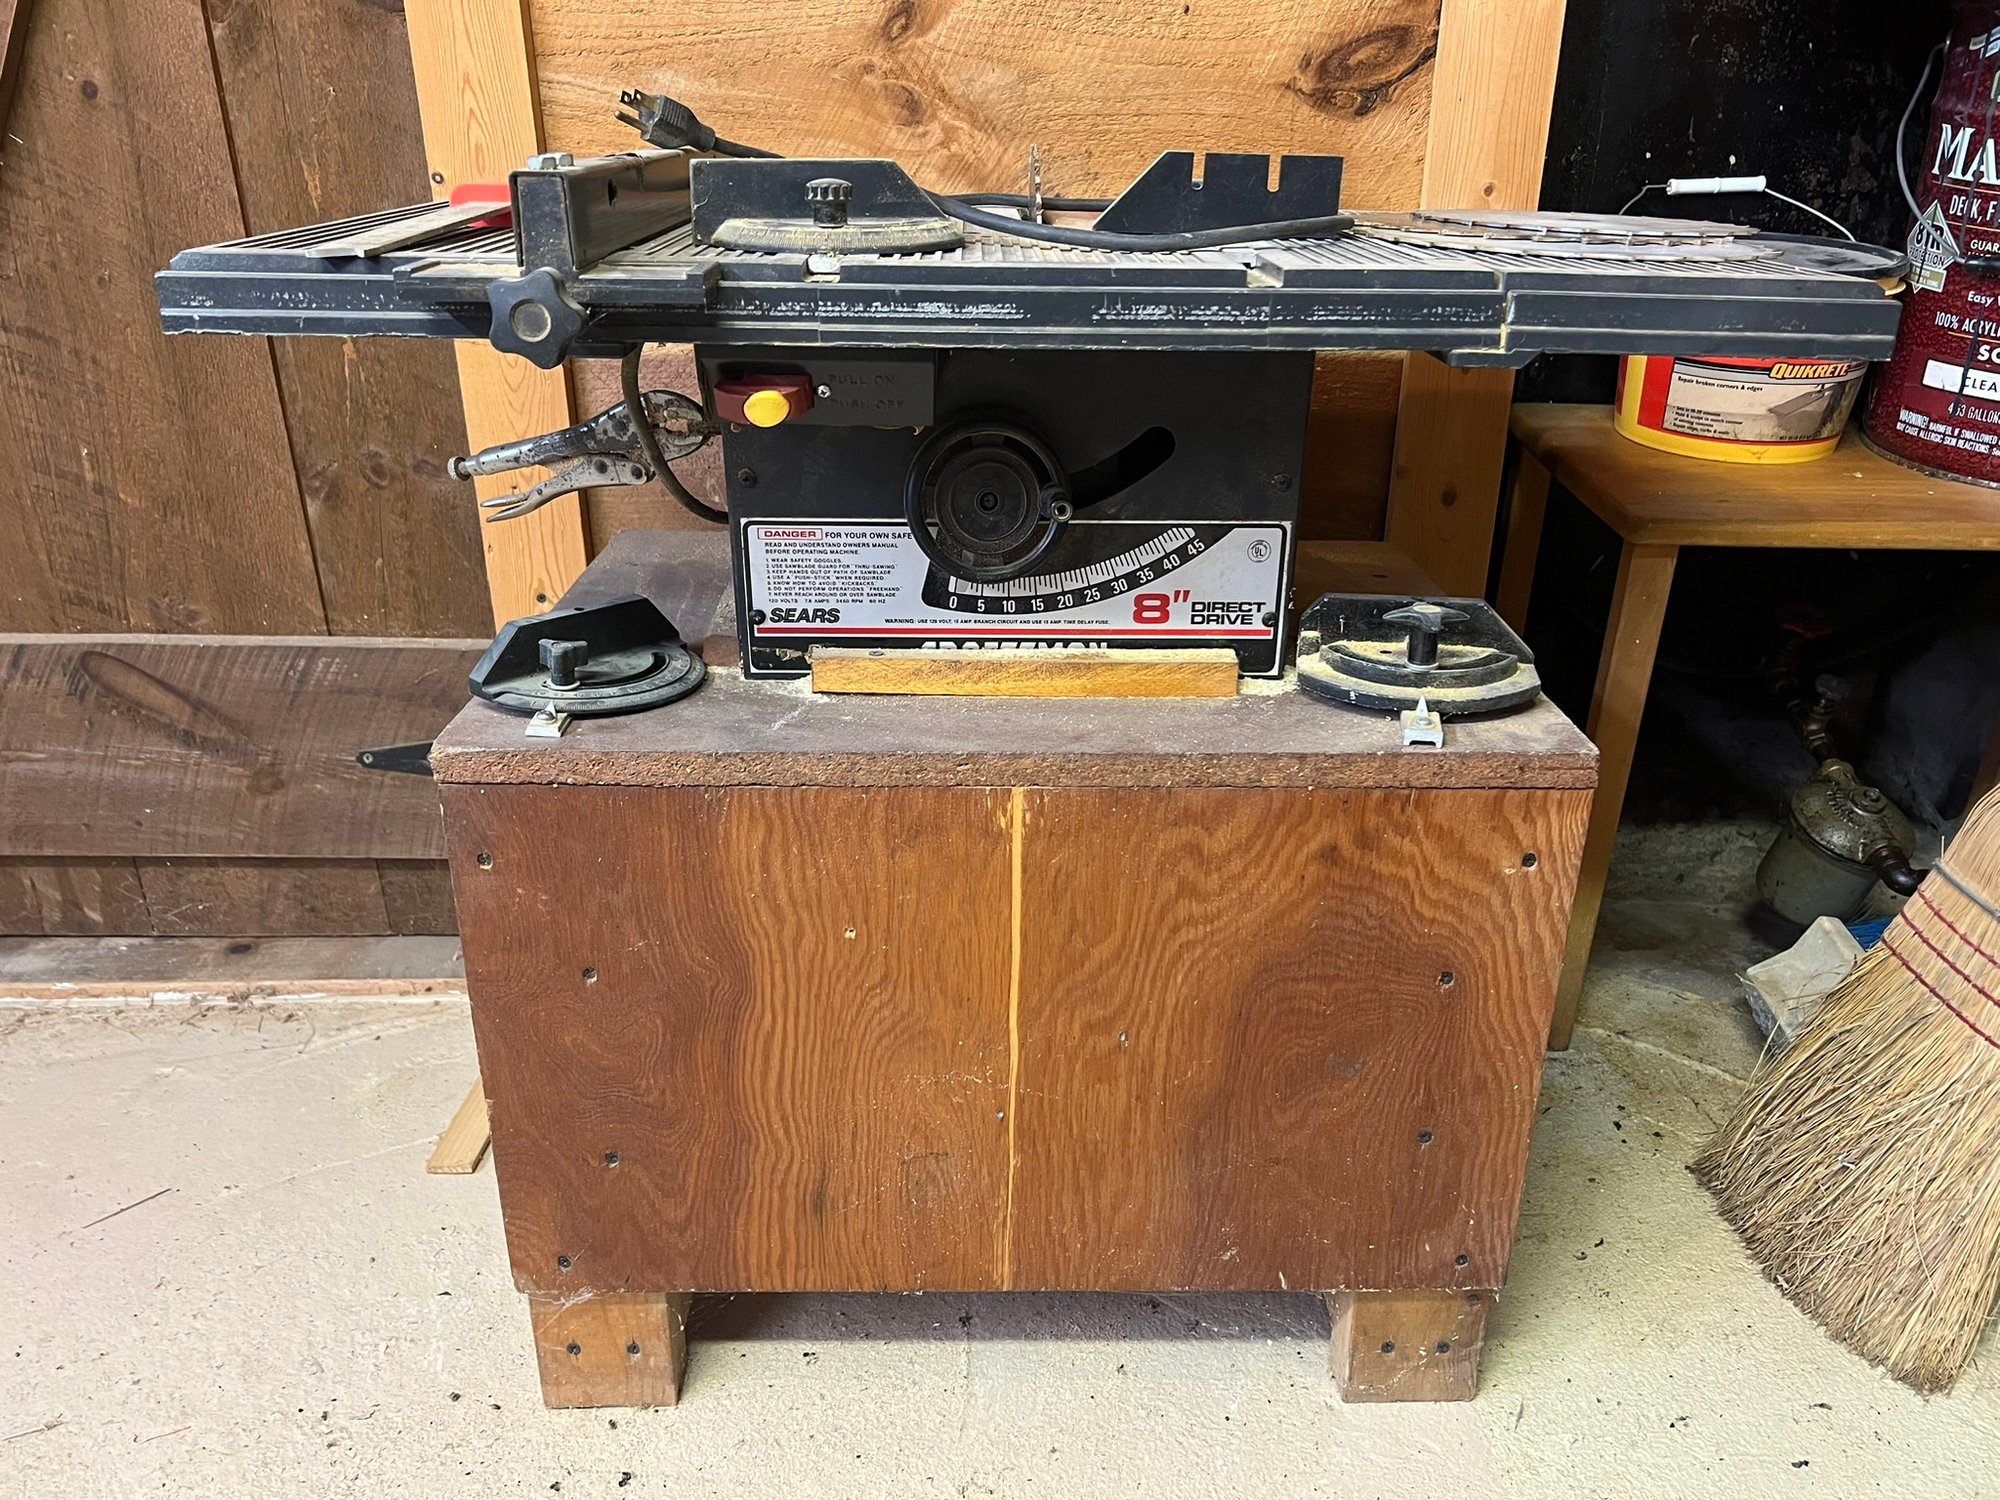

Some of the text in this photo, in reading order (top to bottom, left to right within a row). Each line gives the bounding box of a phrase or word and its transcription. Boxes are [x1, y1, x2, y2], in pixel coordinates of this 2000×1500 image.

[1968, 291, 1994, 307] Easy
[1935, 312, 1960, 330] 100%
[1770, 363, 1850, 378] QUIKRETE
[1678, 376, 1694, 384] Repair
[1900, 408, 1929, 428] WARNING!
[1954, 428, 1960, 436] IF
[1961, 430, 1998, 444] SWALLOWED
[1919, 430, 1944, 444] ALLERGIC
[950, 538, 1205, 612] 0 5 10 15 20 25 30 35 40 45
[1132, 590, 1190, 624] 8"
[1191, 602, 1266, 612] DIRECT
[770, 608, 840, 623] SEARS
[1190, 614, 1253, 624] DRIVE
